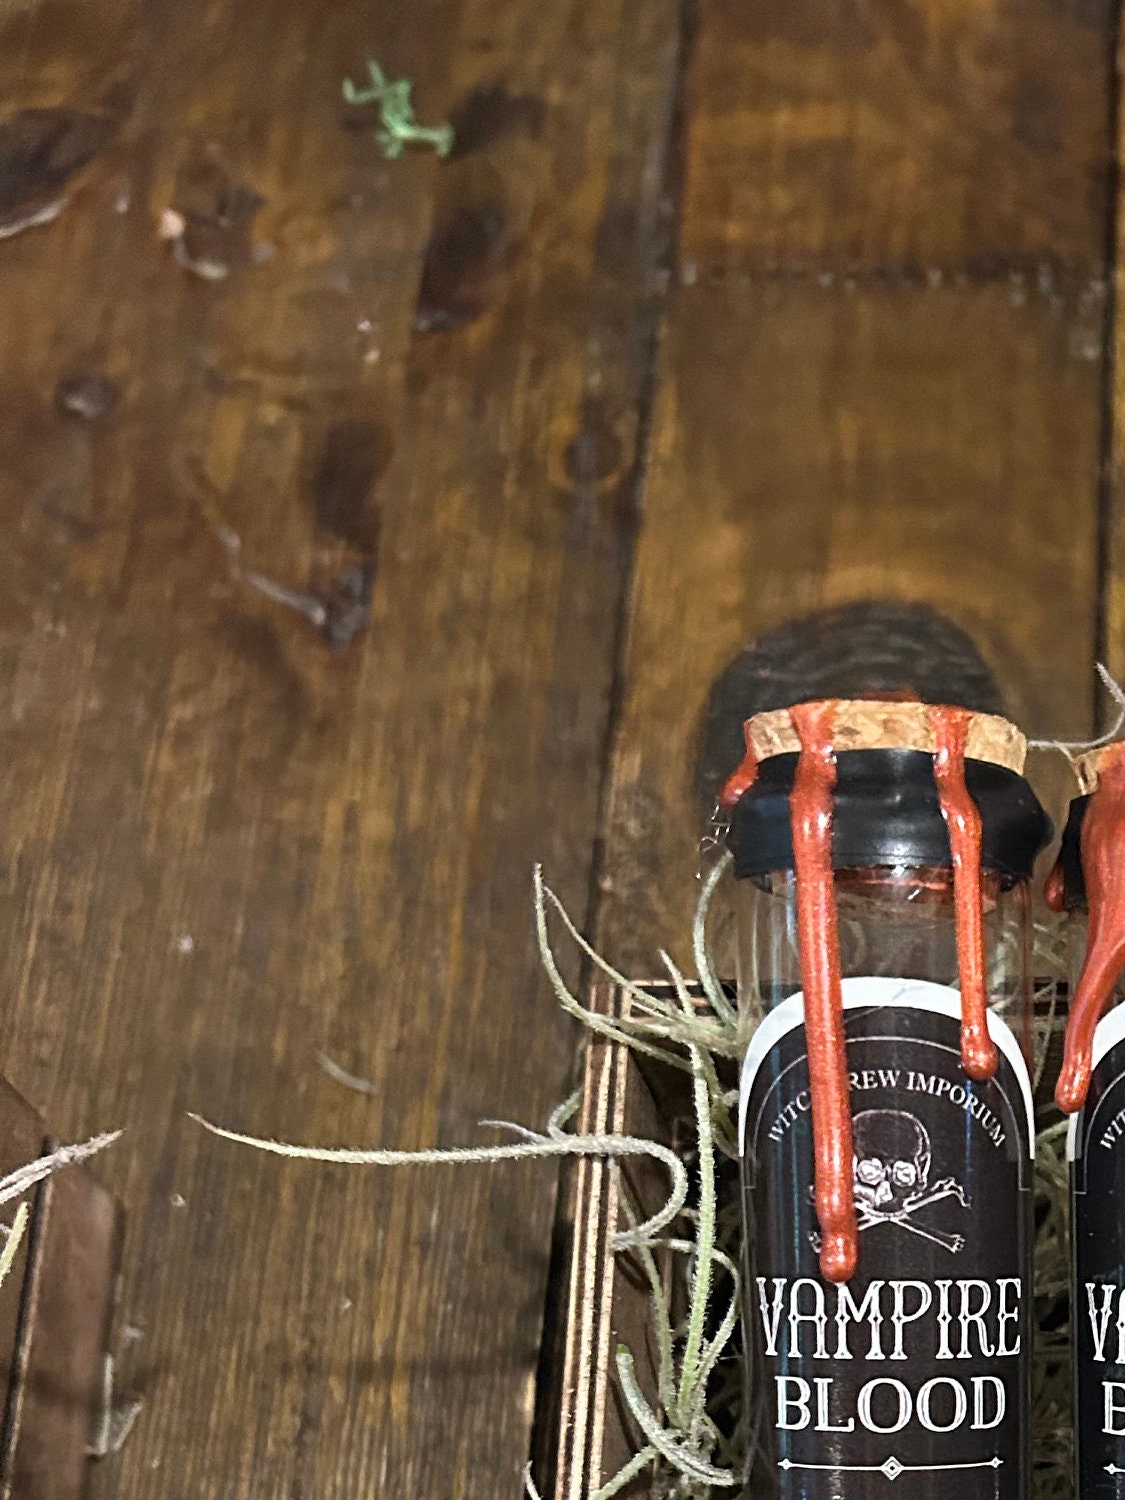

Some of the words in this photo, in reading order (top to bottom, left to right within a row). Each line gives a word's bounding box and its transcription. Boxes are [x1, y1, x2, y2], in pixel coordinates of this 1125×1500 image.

[768, 1088, 811, 1142] WITC
[848, 1069, 902, 1091] REW
[905, 1070, 1007, 1148] IMPORIUM
[756, 1276, 1023, 1361] VAMPIRE
[774, 1375, 1007, 1434] BLOOD
